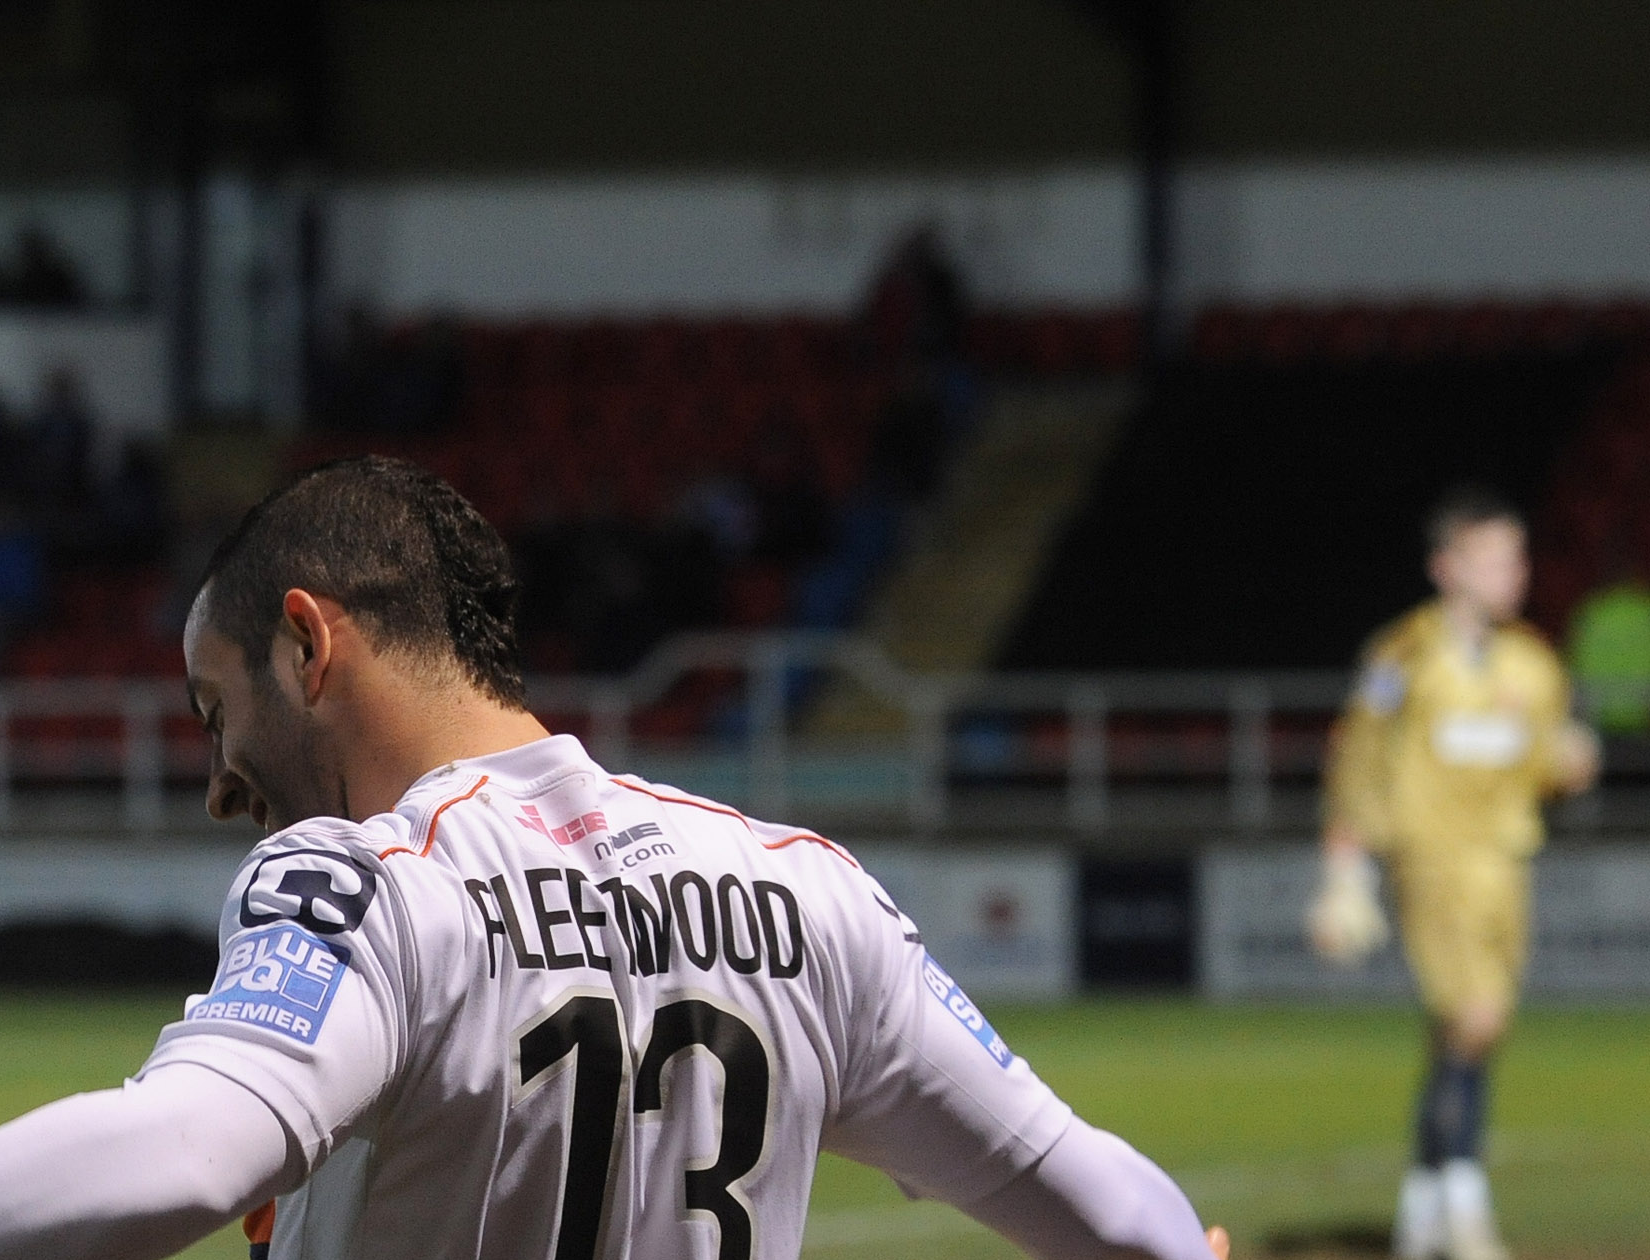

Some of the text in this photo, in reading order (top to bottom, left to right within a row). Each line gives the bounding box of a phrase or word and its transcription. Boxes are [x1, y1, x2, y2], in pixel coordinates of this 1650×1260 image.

[619, 842, 676, 872] .com
[226, 931, 338, 981] BLUE
[192, 1001, 312, 1038] PREMIER
